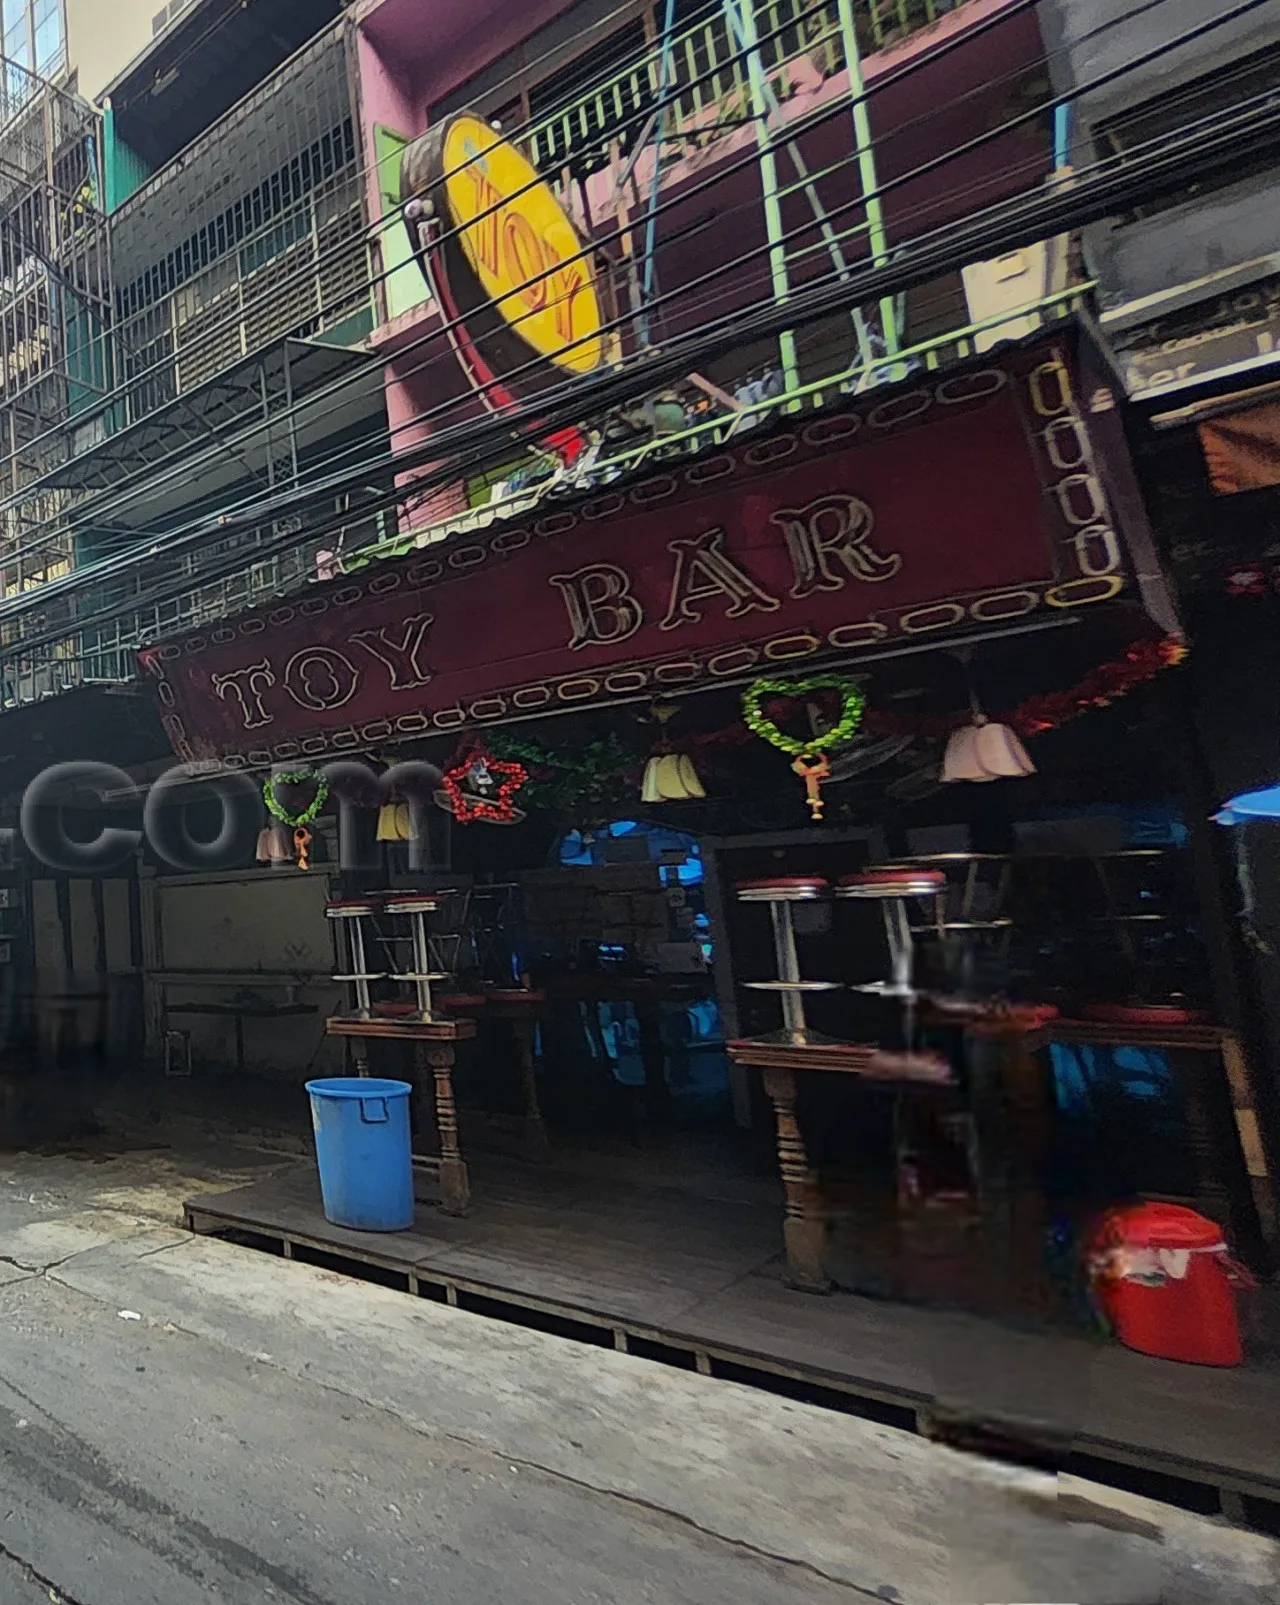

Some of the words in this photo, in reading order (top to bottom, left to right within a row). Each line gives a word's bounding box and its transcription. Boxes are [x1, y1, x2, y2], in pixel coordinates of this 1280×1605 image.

[464, 164, 583, 344] TOY
[211, 612, 440, 730] TOY
[549, 493, 906, 653] BAR
